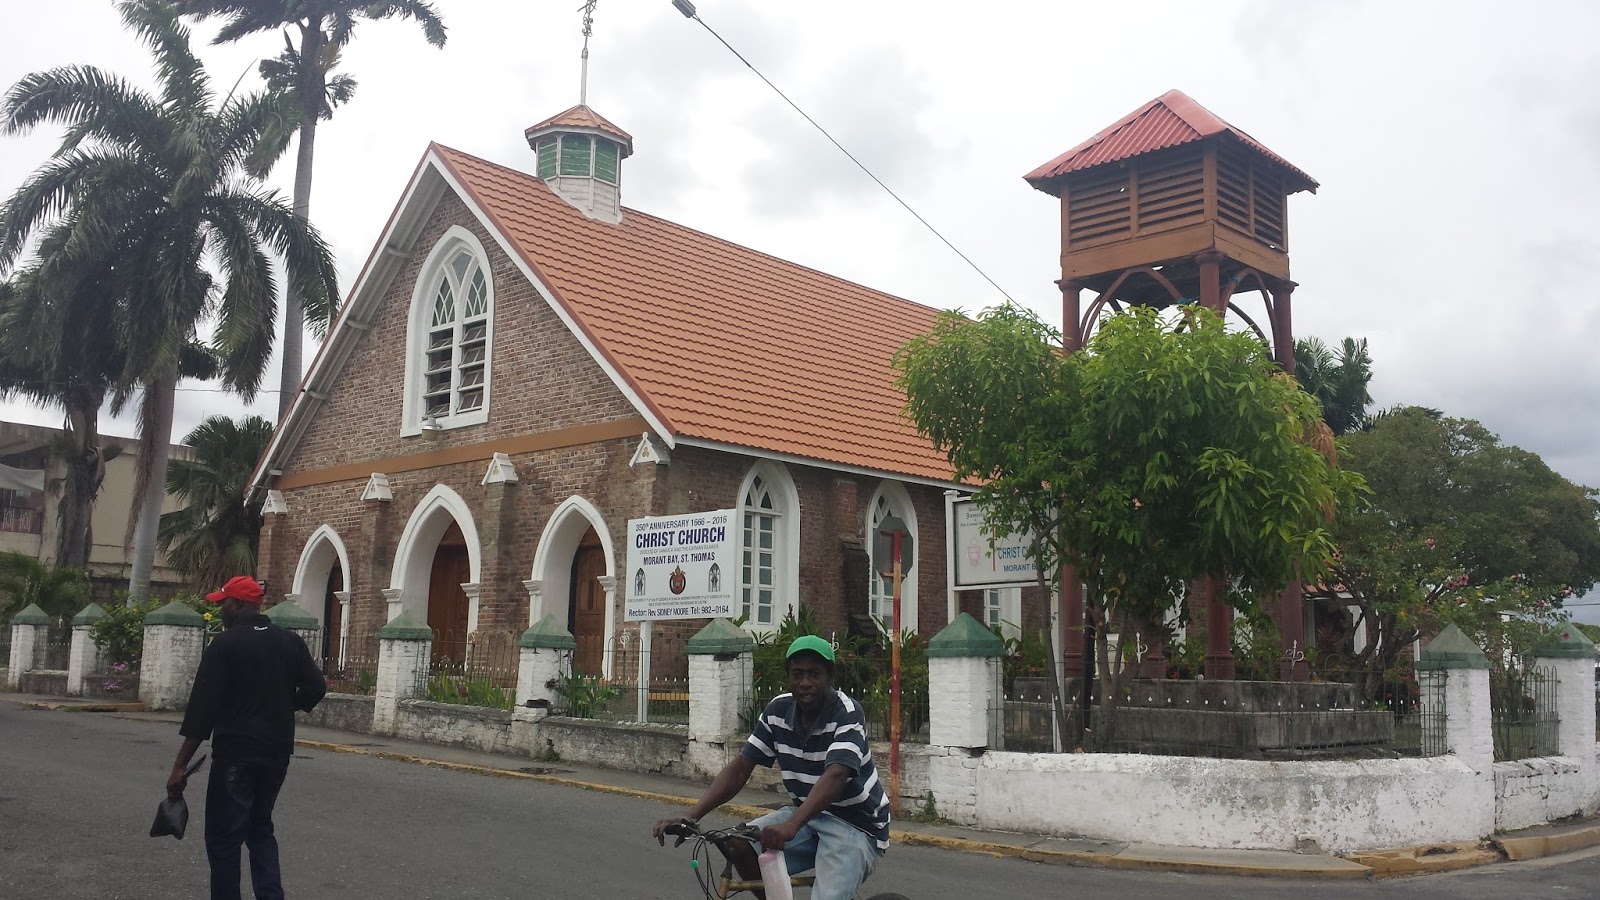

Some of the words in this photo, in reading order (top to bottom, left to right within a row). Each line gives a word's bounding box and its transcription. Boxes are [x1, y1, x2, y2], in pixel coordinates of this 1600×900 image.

[649, 519, 689, 530] ANNIVERSARY
[691, 518, 706, 527] 1666
[712, 516, 728, 525] 2016
[636, 532, 675, 548] CHRIST
[678, 526, 725, 545] CHURCH
[643, 556, 666, 565] MORANT
[668, 554, 680, 564] BAY,
[681, 553, 690, 563] ST.
[691, 552, 716, 562] THOMAS
[998, 546, 1020, 559] CHRIST
[1004, 563, 1030, 572] MORANT
[629, 608, 648, 617] Rector:
[657, 608, 672, 617] SIDNEY
[673, 607, 689, 616] MOORE
[691, 606, 701, 615] Tel:
